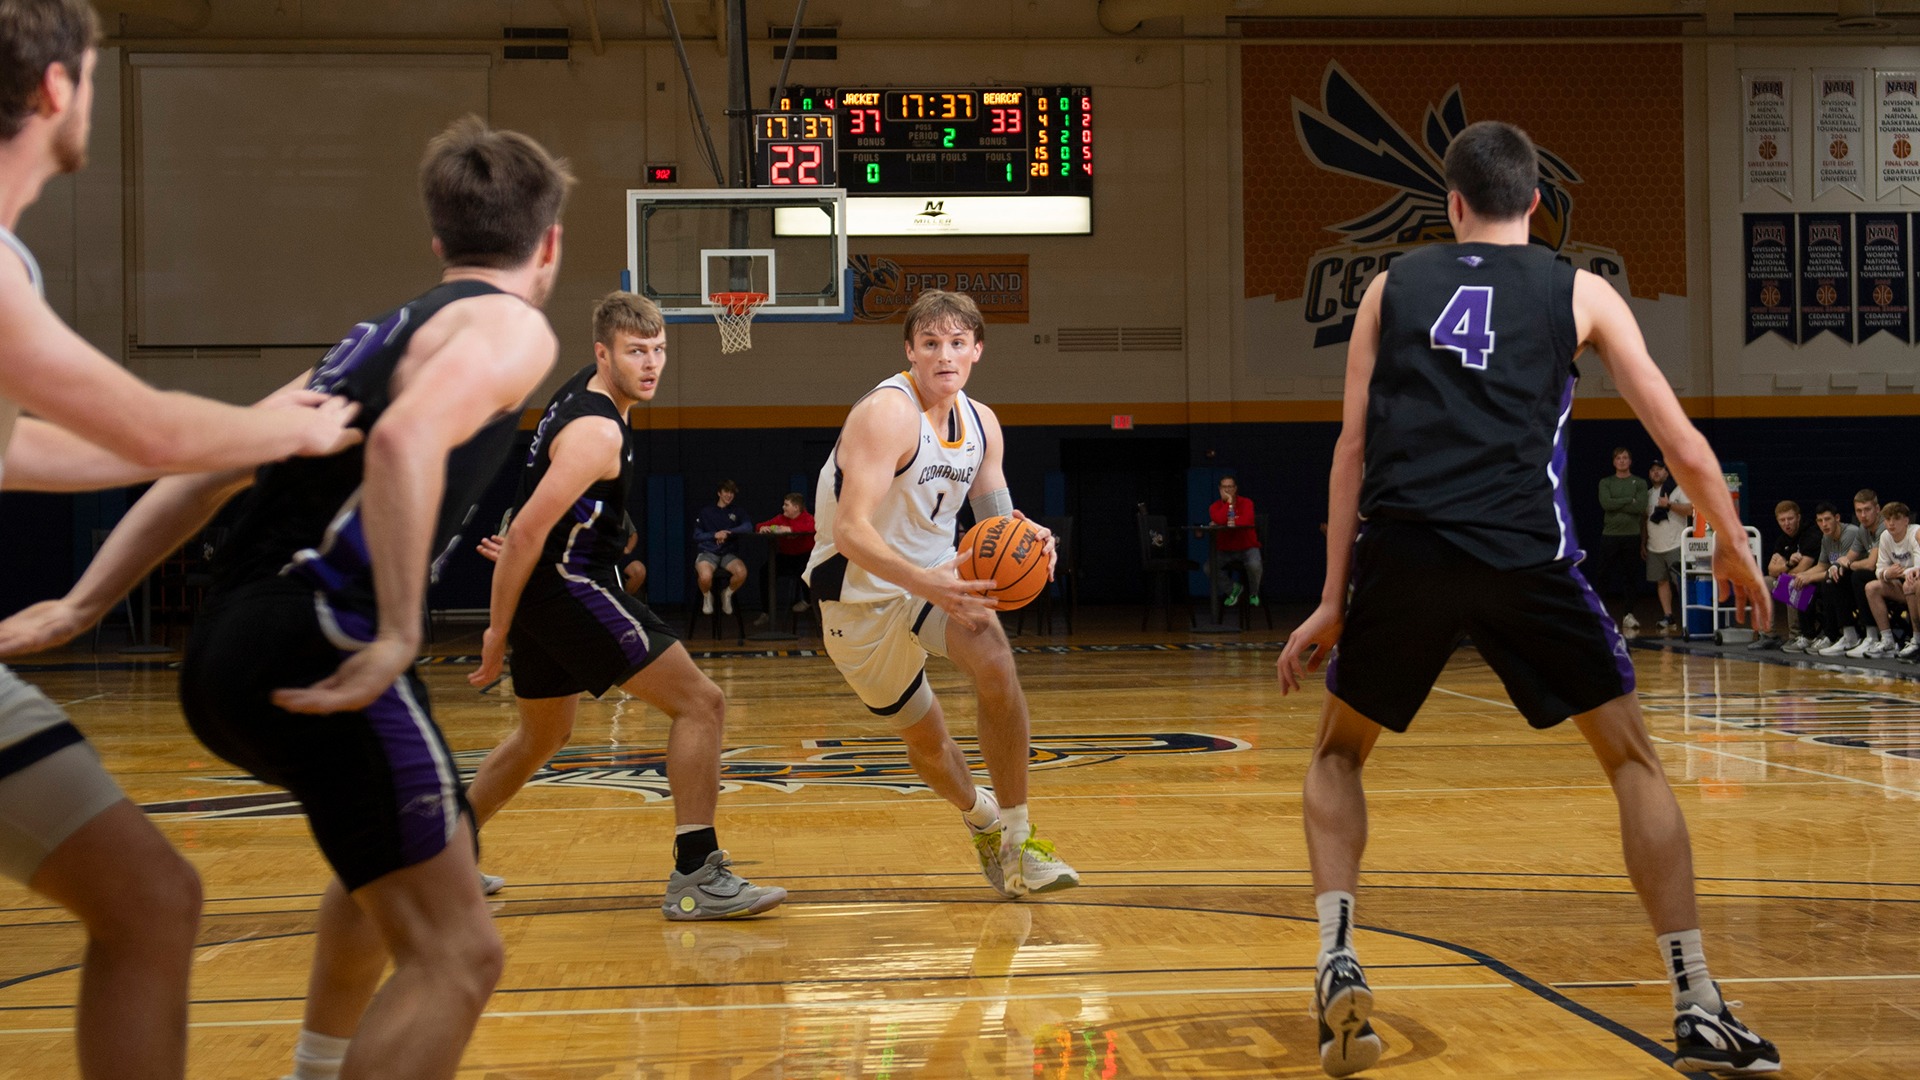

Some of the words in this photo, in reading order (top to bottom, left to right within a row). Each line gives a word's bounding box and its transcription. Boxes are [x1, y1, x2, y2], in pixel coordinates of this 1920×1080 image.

[1824, 80, 1852, 95] NAIA
[1887, 80, 1915, 94] NAIA
[842, 93, 880, 105] JACKET
[901, 94, 972, 118] 17:37
[1038, 97, 1048, 111] 0
[1060, 97, 1069, 111] 0
[1081, 97, 1091, 111] 6
[849, 109, 881, 134] 37
[991, 109, 1021, 134] 33
[1038, 113, 1048, 127] 4
[1081, 113, 1091, 127] 2
[766, 117, 833, 138] 17:37
[857, 138, 886, 147] BONUS
[908, 131, 939, 140] PERIOD
[943, 127, 956, 148] 2
[979, 137, 1007, 146] BONUS
[1038, 130, 1048, 144] 5
[1060, 130, 1070, 144] 2
[1082, 130, 1092, 144] 0
[853, 153, 880, 162] FOULS
[905, 153, 937, 162] PLAYER
[941, 153, 967, 162] FOULS
[985, 153, 1012, 162] FOULS
[1034, 146, 1048, 160] 15
[1060, 146, 1070, 160] 0
[1082, 146, 1092, 160] 5
[770, 145, 821, 185] 22
[1005, 162, 1012, 182] 1
[1030, 162, 1049, 176] 20
[1060, 162, 1070, 176] 2
[1082, 162, 1092, 176] 4
[866, 162, 880, 184] 0
[1754, 227, 1783, 241] NAIA
[1811, 227, 1839, 241] NAIA
[1868, 227, 1896, 240] NAIA
[905, 273, 949, 292] PEP
[956, 273, 1021, 292] BAND
[875, 296, 914, 305] BACK
[1429, 285, 1496, 370] 4
[930, 491, 946, 521] 1
